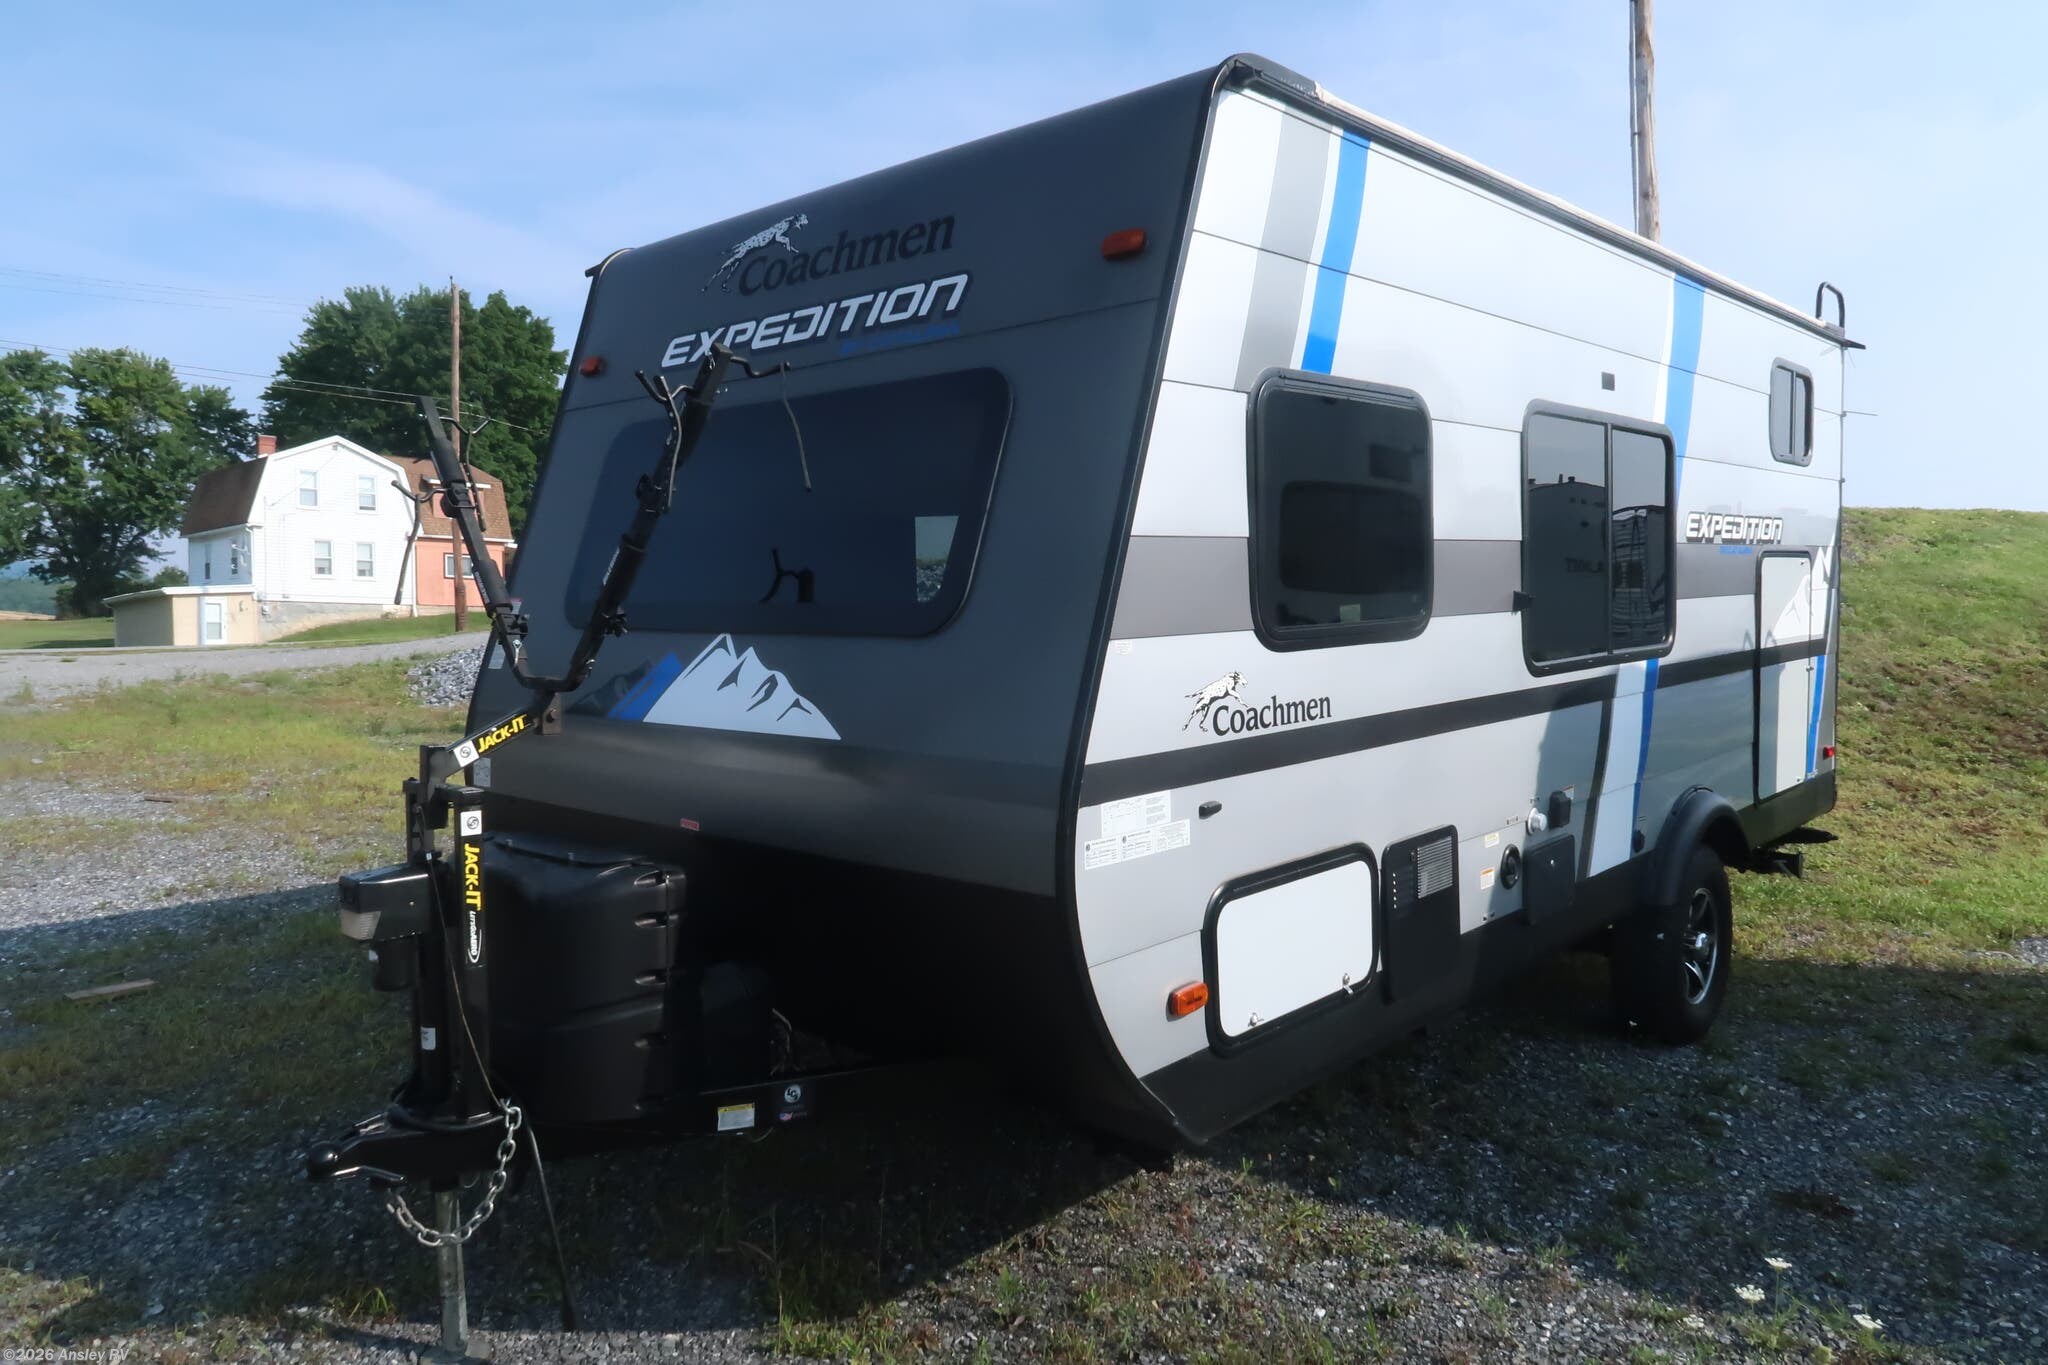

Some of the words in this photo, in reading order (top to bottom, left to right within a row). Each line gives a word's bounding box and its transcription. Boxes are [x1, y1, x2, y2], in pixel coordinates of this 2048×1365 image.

[738, 215, 955, 296] Coachmen
[661, 274, 969, 368] EXPEDITION
[1686, 511, 1783, 544] EXPEDITION
[477, 713, 527, 753] JACK-IT
[1212, 695, 1332, 737] Coachmen
[464, 843, 482, 911] JACK-IT
